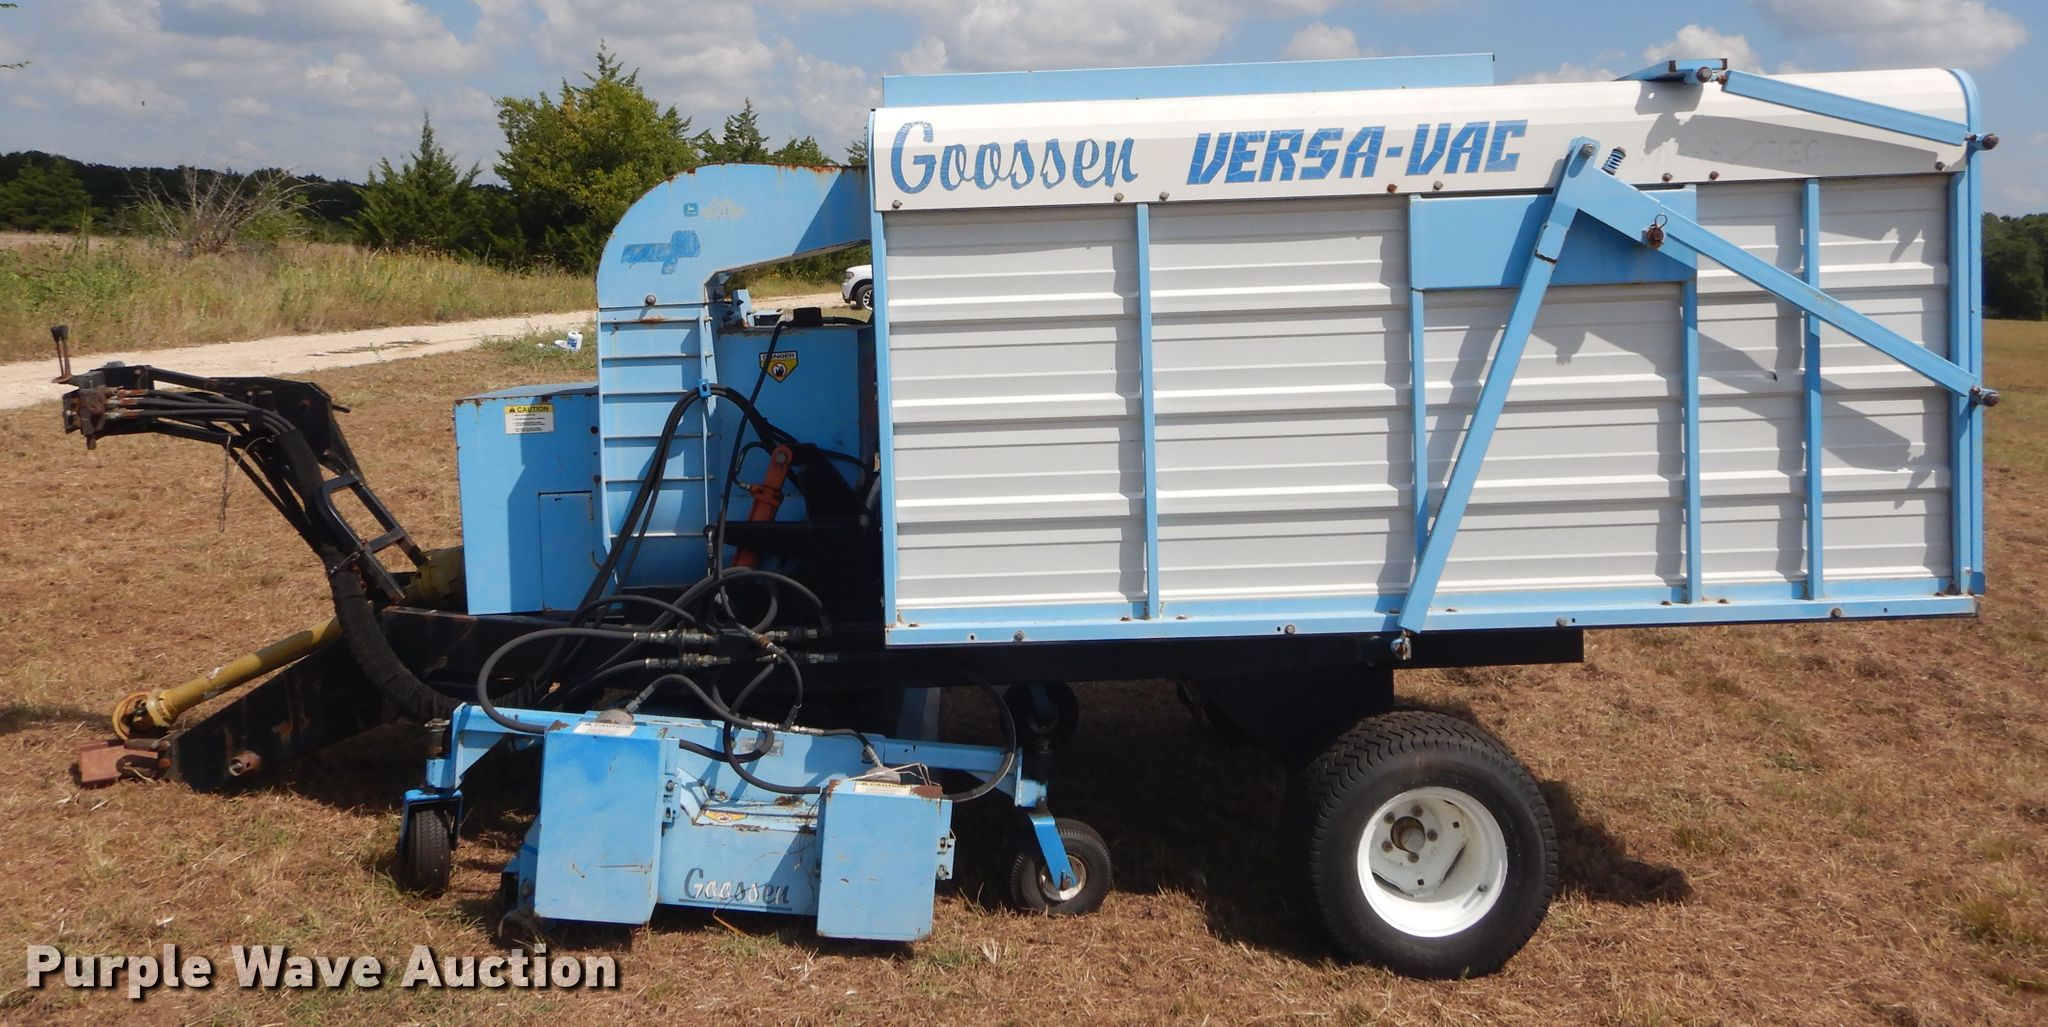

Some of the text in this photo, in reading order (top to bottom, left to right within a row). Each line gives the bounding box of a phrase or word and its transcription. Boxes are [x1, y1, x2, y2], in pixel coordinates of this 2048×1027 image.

[890, 119, 1528, 195] Goossen VERSA-VAC
[762, 352, 796, 360] DNGER
[517, 405, 549, 413] CAUTION
[684, 867, 790, 905] Goossen
